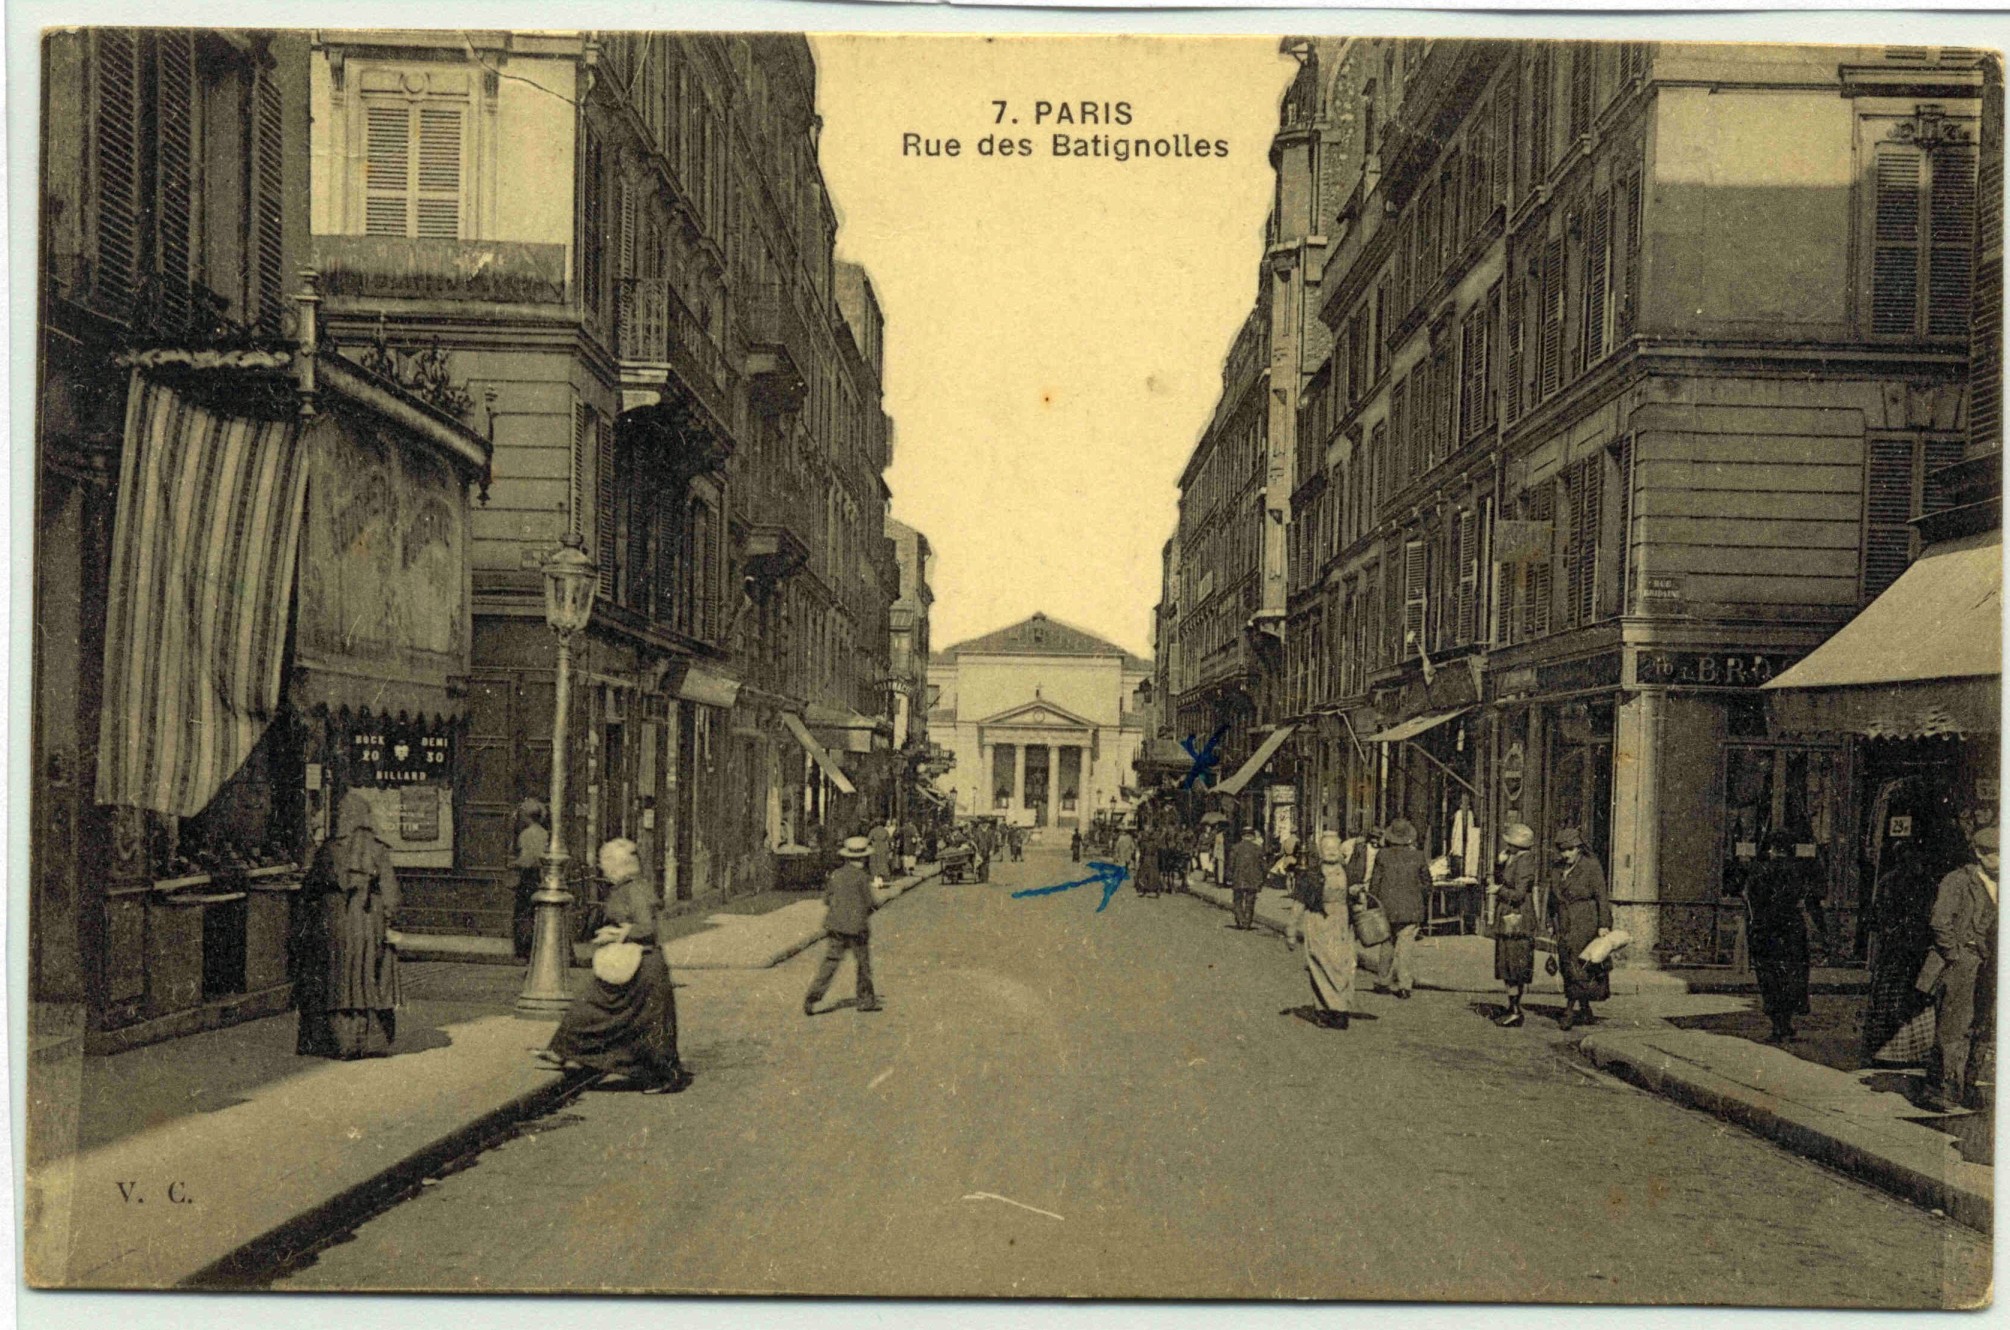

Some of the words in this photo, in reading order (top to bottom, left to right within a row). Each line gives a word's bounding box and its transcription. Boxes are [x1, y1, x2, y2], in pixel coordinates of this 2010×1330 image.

[355, 735, 385, 745] BOCK
[421, 737, 448, 747] DEMI
[362, 751, 380, 762] 20
[376, 771, 427, 781] BILLARD
